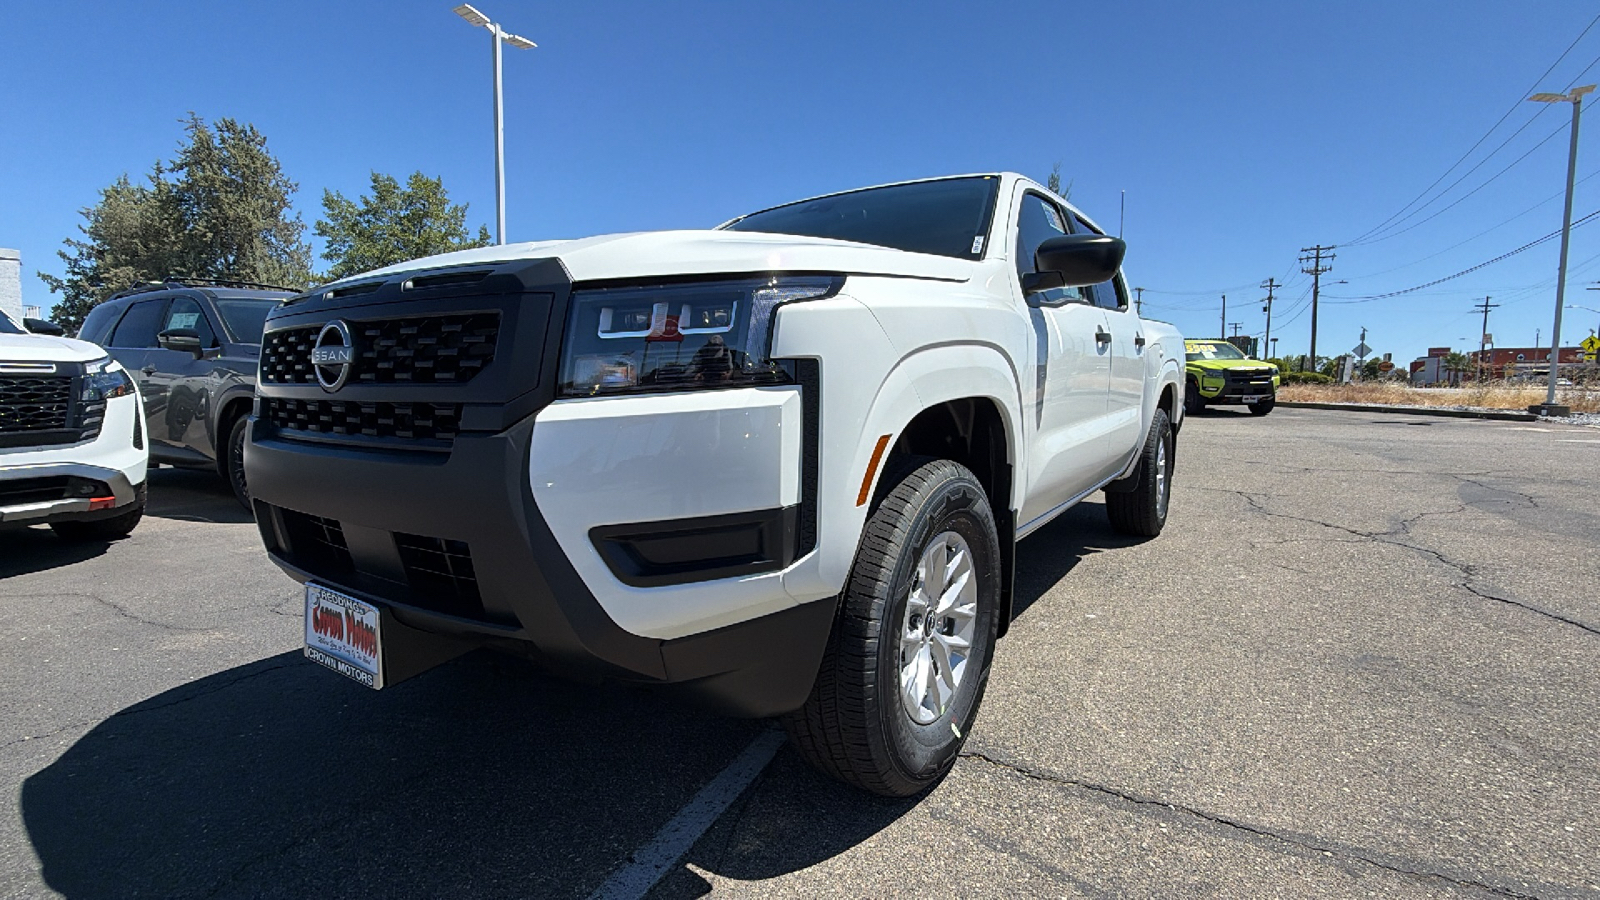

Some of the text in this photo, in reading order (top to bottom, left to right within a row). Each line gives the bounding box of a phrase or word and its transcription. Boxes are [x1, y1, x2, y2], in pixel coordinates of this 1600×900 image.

[315, 350, 350, 361] SSAN
[308, 648, 374, 686] CROWN MOTORS
